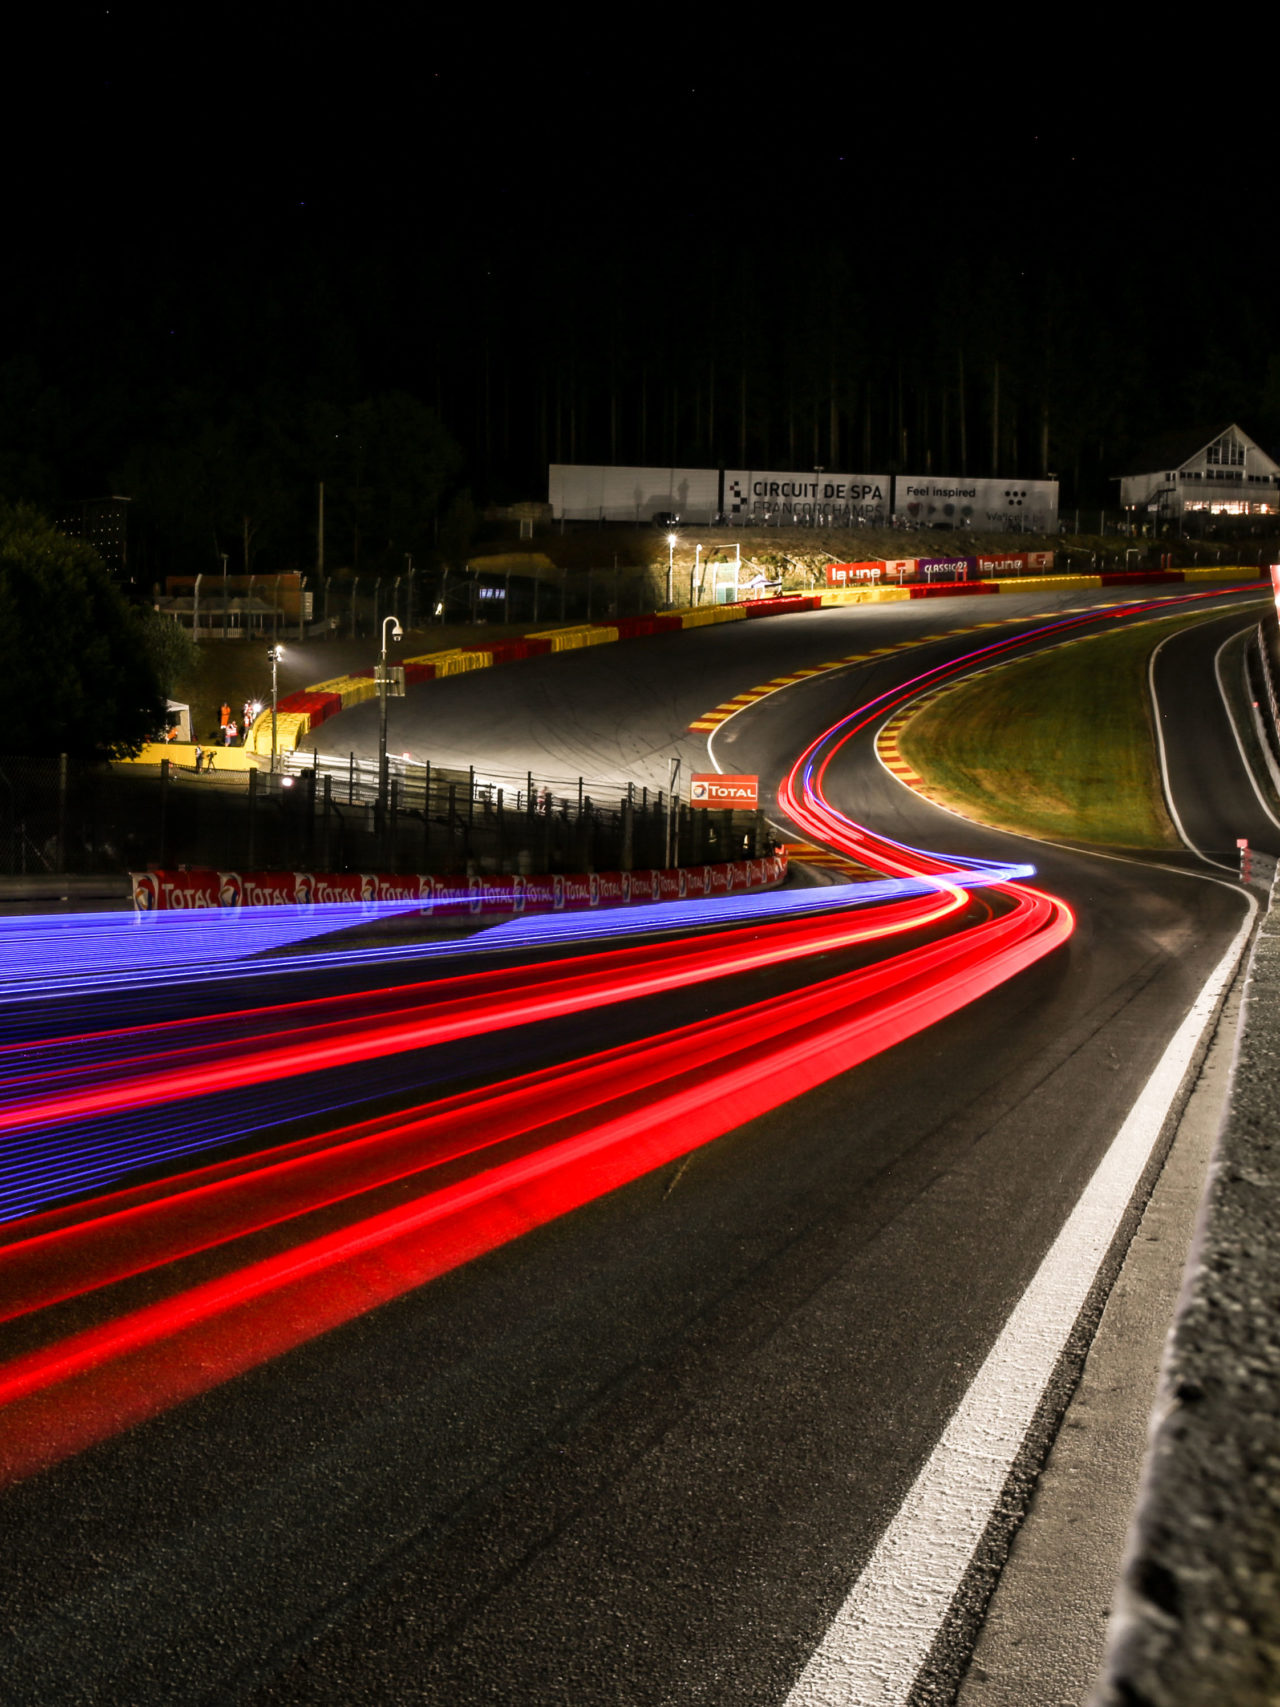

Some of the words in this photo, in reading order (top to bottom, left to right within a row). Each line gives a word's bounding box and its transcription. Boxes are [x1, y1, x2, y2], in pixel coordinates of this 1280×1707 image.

[753, 482, 819, 498] CIRCUIT
[824, 484, 846, 499] DE
[851, 484, 883, 500] SPA
[907, 486, 929, 496] Feel
[933, 487, 976, 498] inspired
[709, 786, 757, 797] TOTAL
[161, 883, 219, 910] TOTAL
[244, 882, 293, 906] TOTAL
[317, 882, 357, 905] TOTAL
[566, 881, 590, 899] TOTAL
